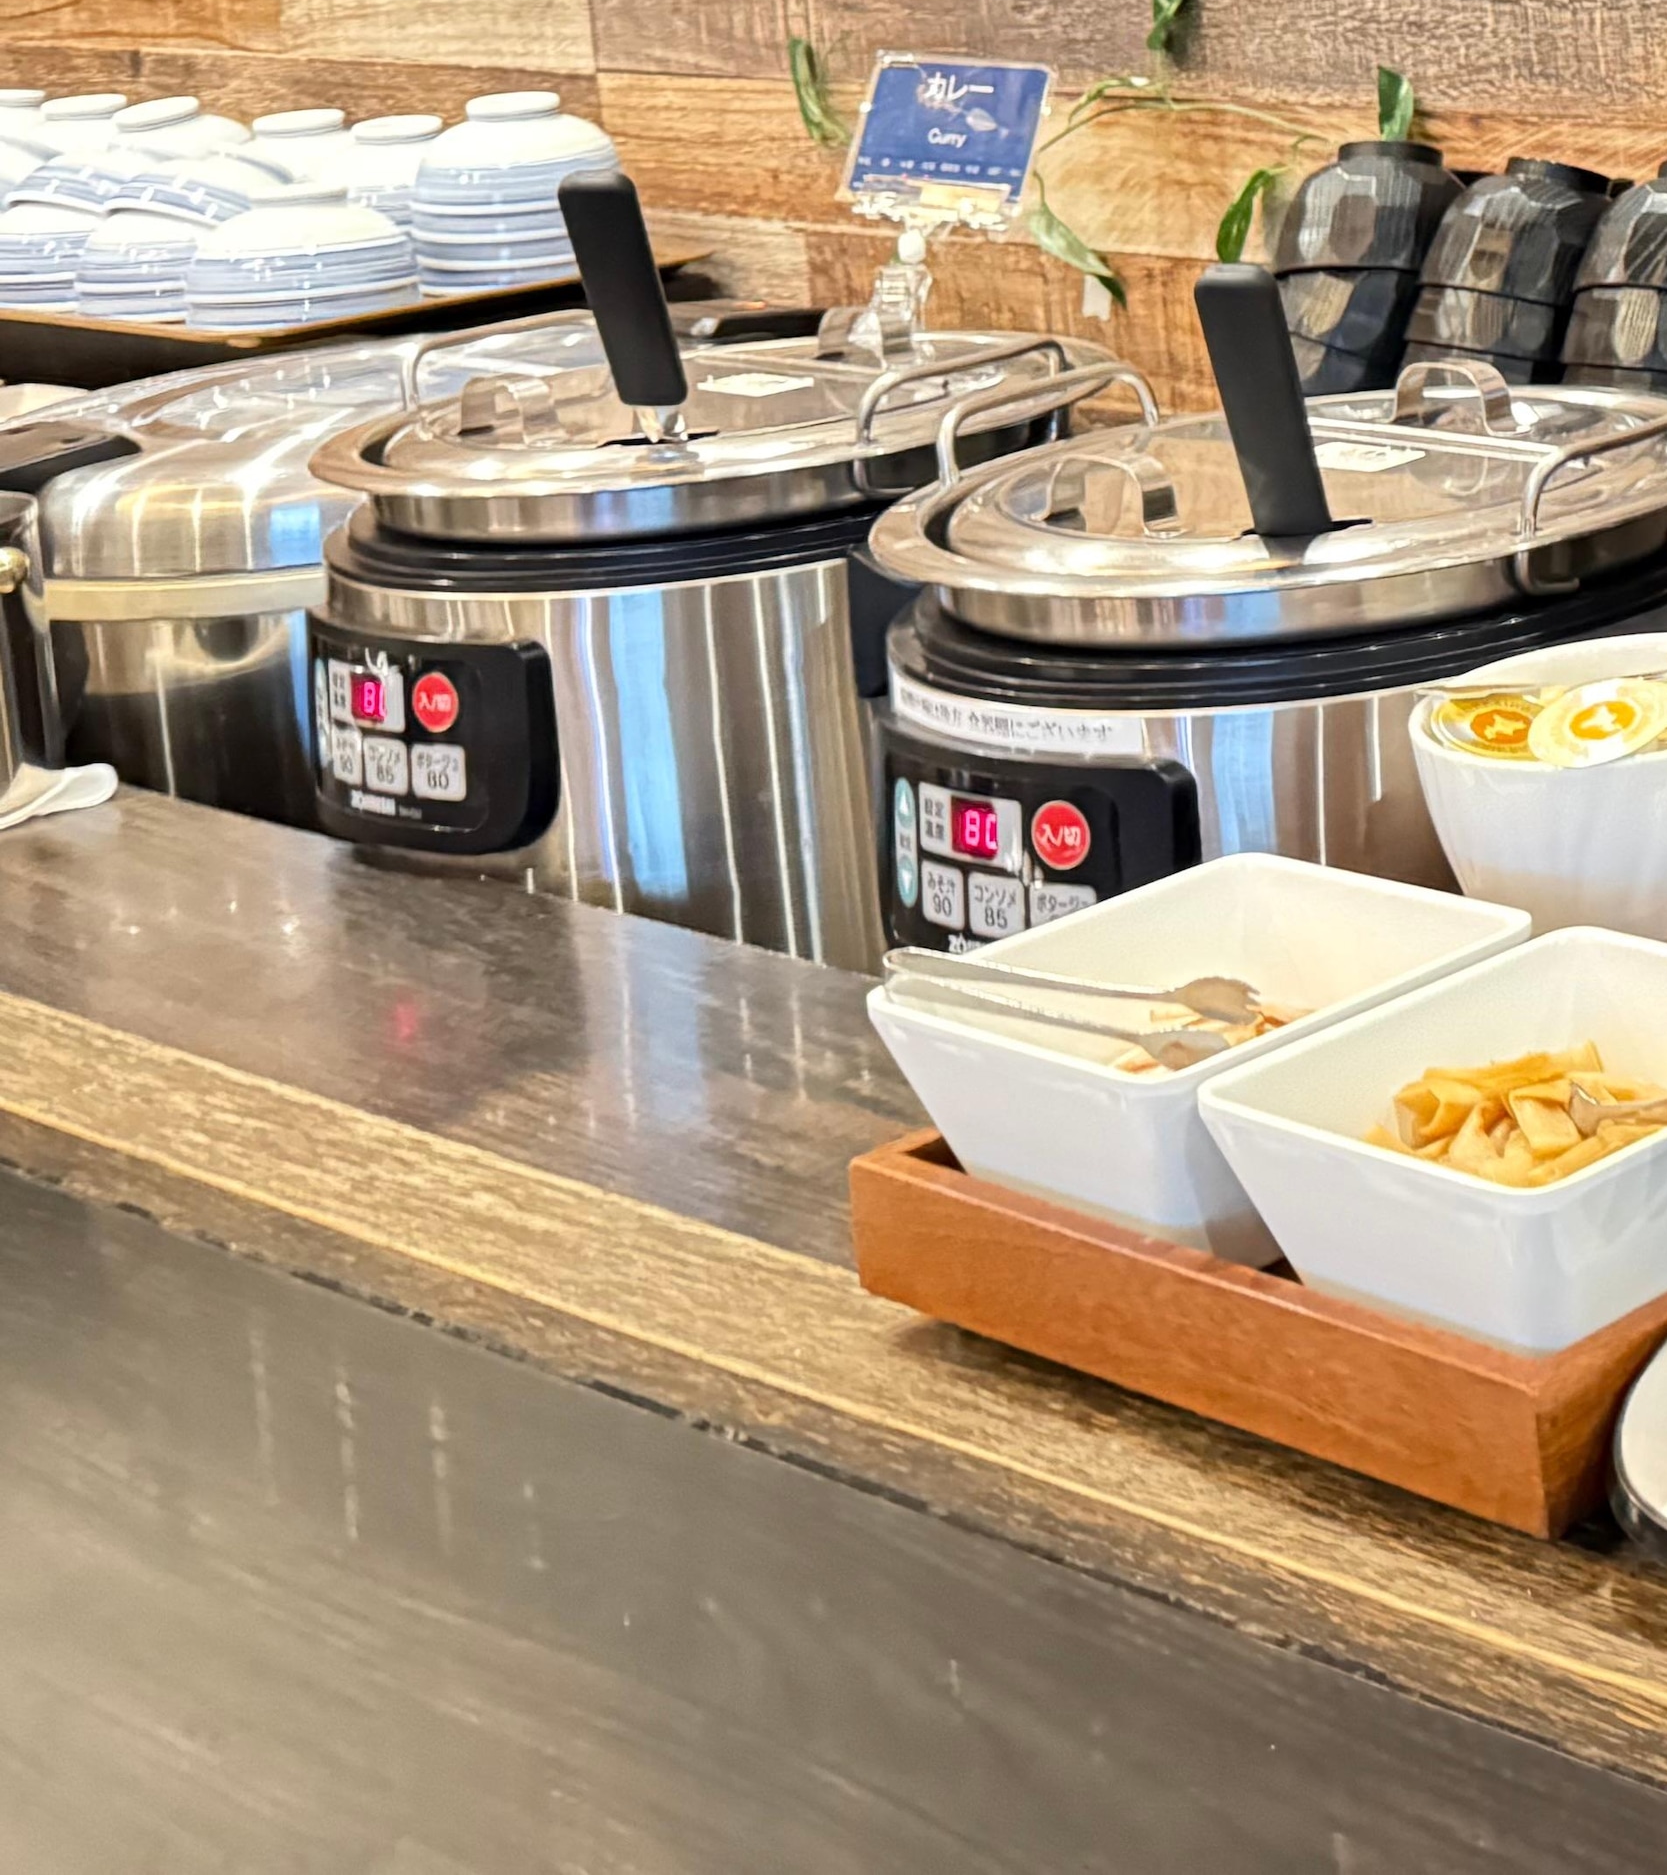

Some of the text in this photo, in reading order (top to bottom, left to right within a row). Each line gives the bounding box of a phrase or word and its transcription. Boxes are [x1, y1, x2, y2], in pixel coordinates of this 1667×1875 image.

[923, 72, 994, 101] カレー
[927, 127, 967, 148] Curry
[933, 894, 951, 917] 90
[974, 884, 1017, 906] コンソメ
[984, 905, 1008, 928] 85
